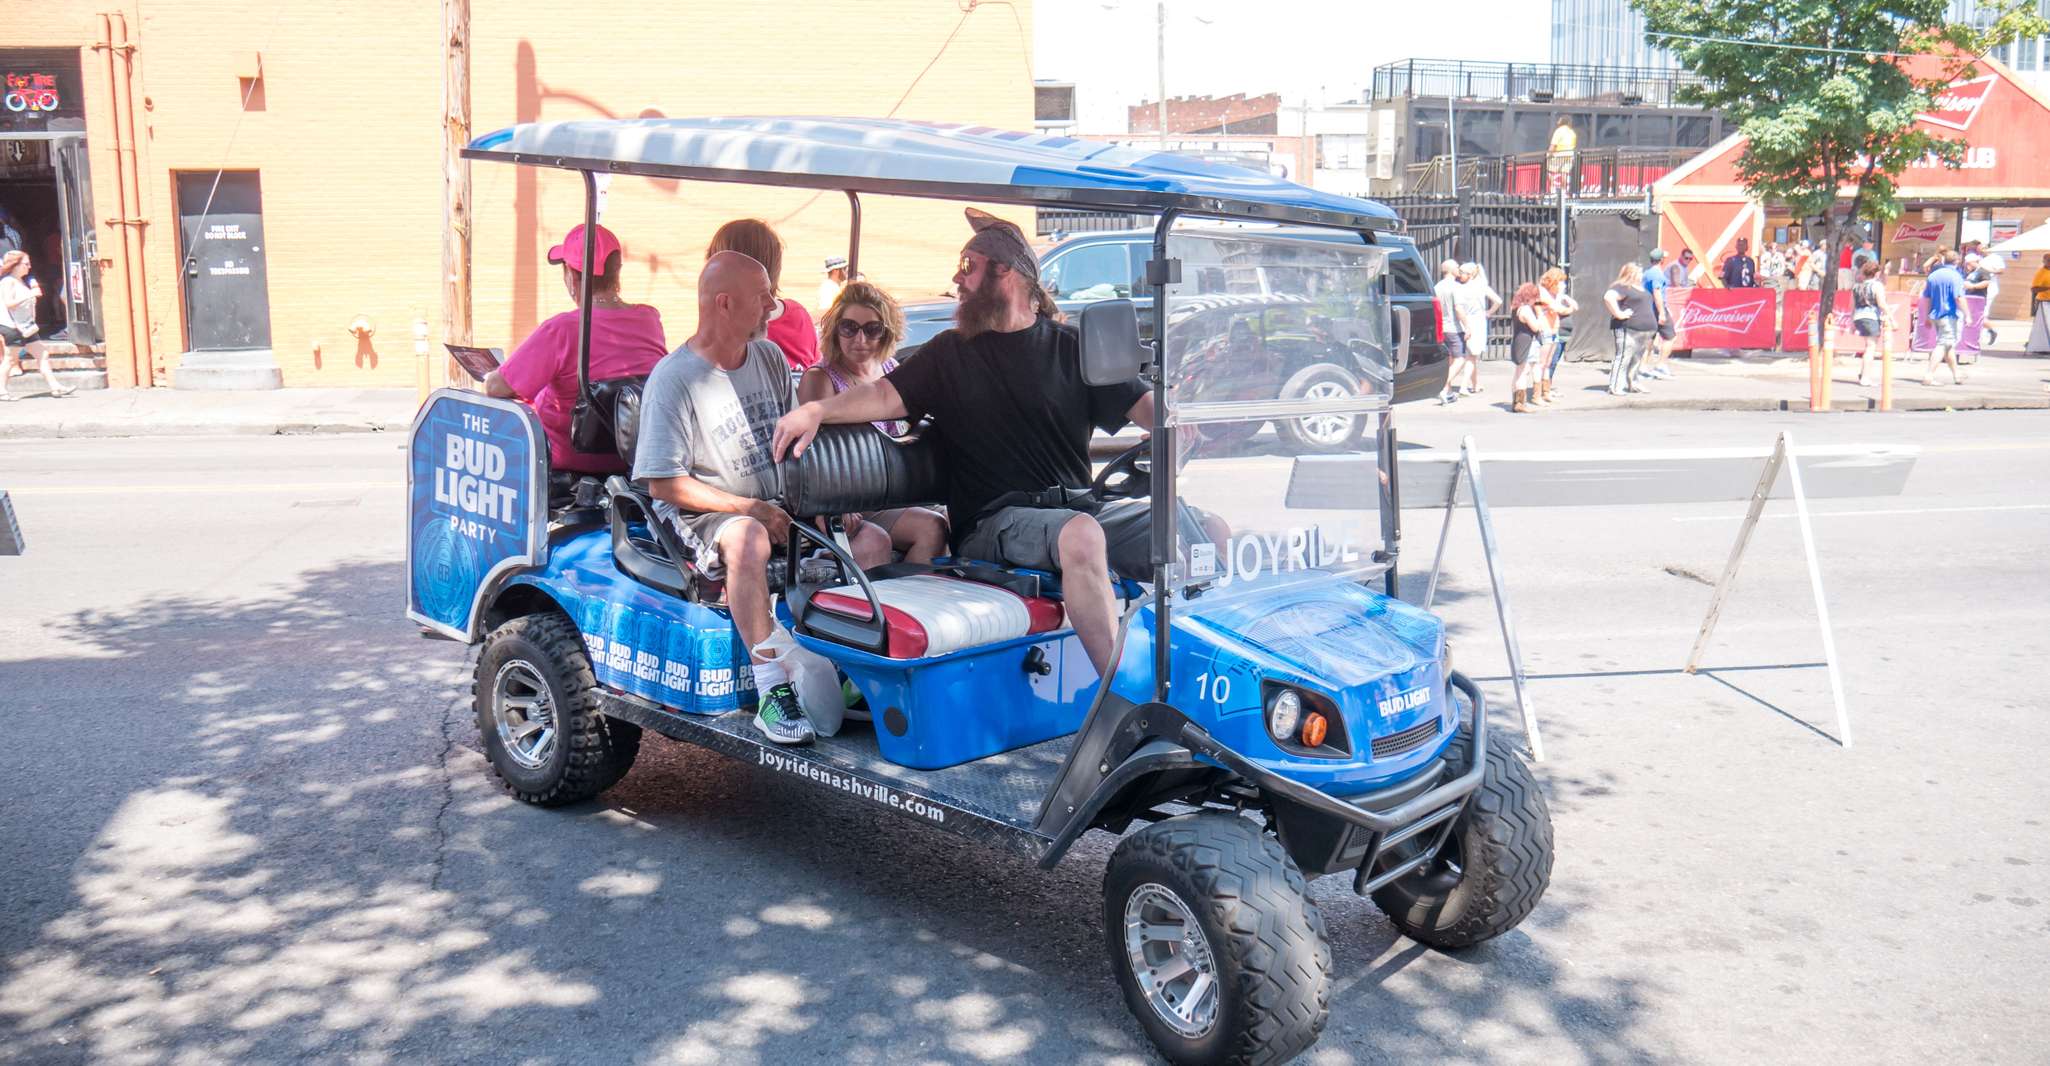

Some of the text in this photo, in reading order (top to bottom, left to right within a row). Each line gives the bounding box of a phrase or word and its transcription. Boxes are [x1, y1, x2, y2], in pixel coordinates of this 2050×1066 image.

[1681, 307, 1756, 325] Budweiser
[462, 412, 491, 435] THE
[445, 432, 507, 482] BUD
[434, 466, 518, 525] LIGHT
[450, 514, 497, 545] PARTY
[1217, 520, 1359, 588] JOYRIDE
[609, 640, 632, 661] BUD
[636, 650, 660, 669] BUD
[605, 652, 633, 673] LIGHT
[632, 661, 661, 683] LIGHT
[665, 659, 690, 679] BUD
[660, 671, 691, 693] LIGHT
[699, 668, 732, 683] BUD
[694, 680, 735, 697] LIGHT
[1195, 672, 1231, 704] 10
[1379, 687, 1431, 718] BUD LIGHT
[758, 747, 945, 823] joyridenashville.com
